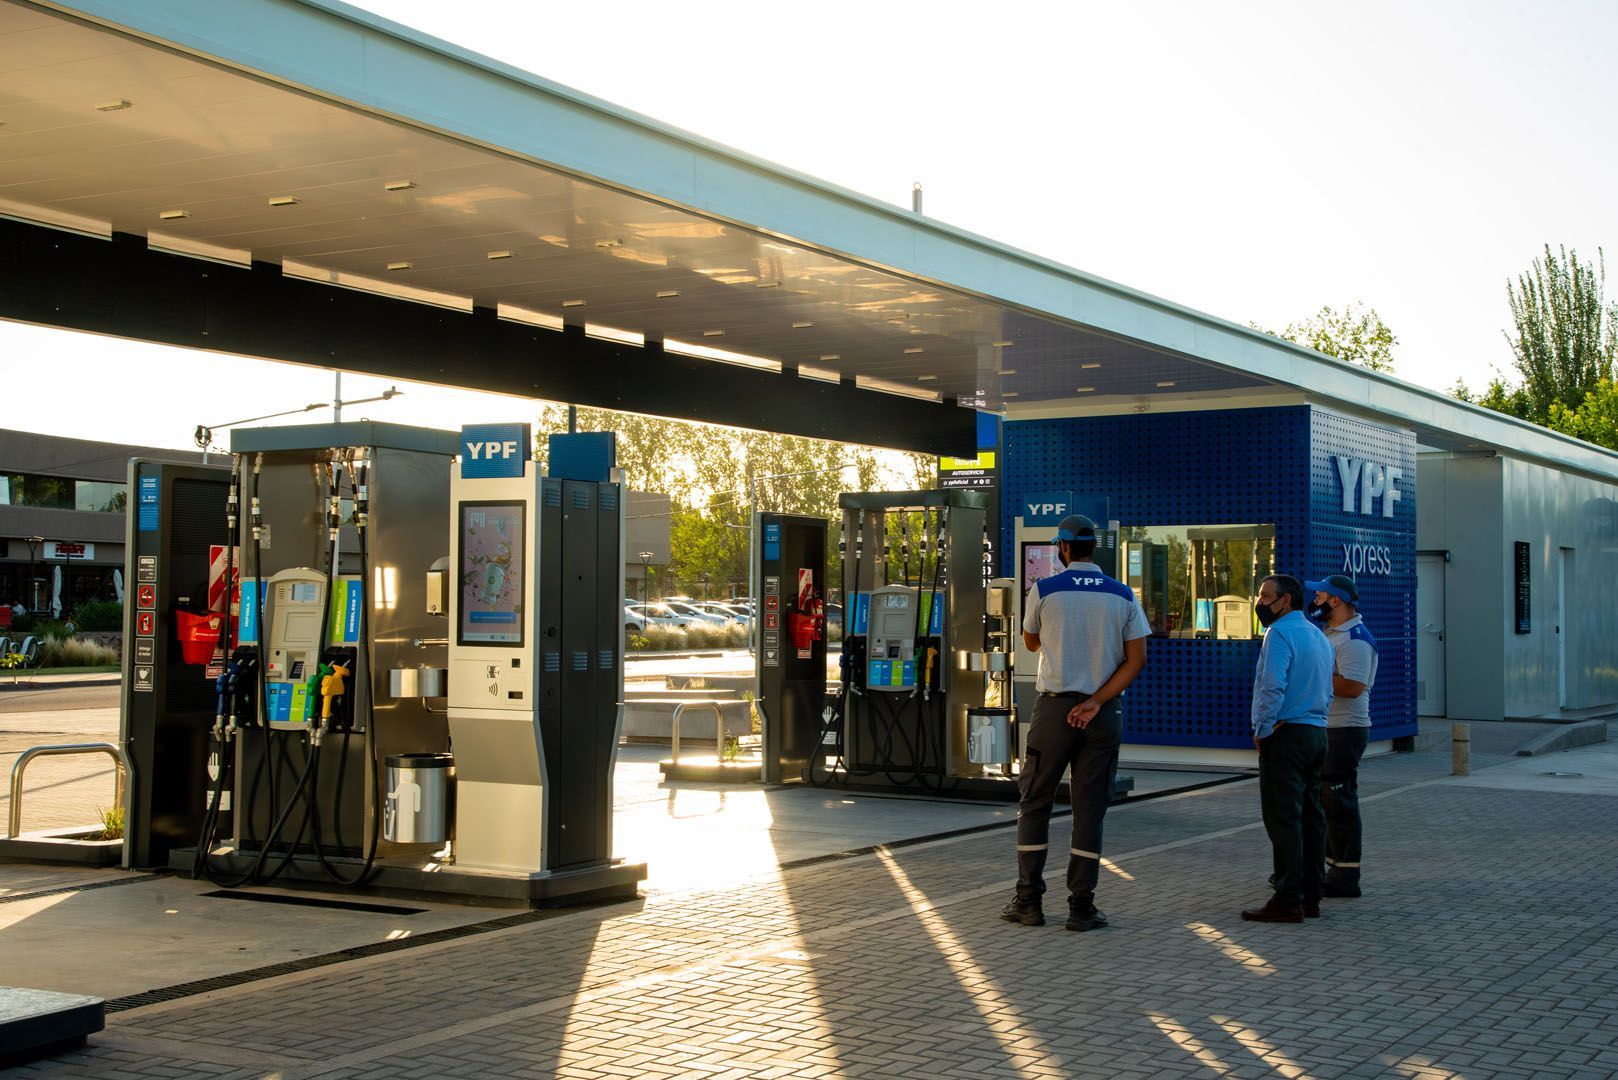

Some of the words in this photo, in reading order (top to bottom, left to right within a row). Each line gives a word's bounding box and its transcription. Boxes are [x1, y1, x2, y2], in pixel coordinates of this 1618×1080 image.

[466, 441, 517, 460] YPF
[1335, 455, 1403, 518] YPF
[1028, 503, 1067, 516] YPF
[1343, 543, 1392, 584] xpress
[1072, 577, 1104, 586] YPF
